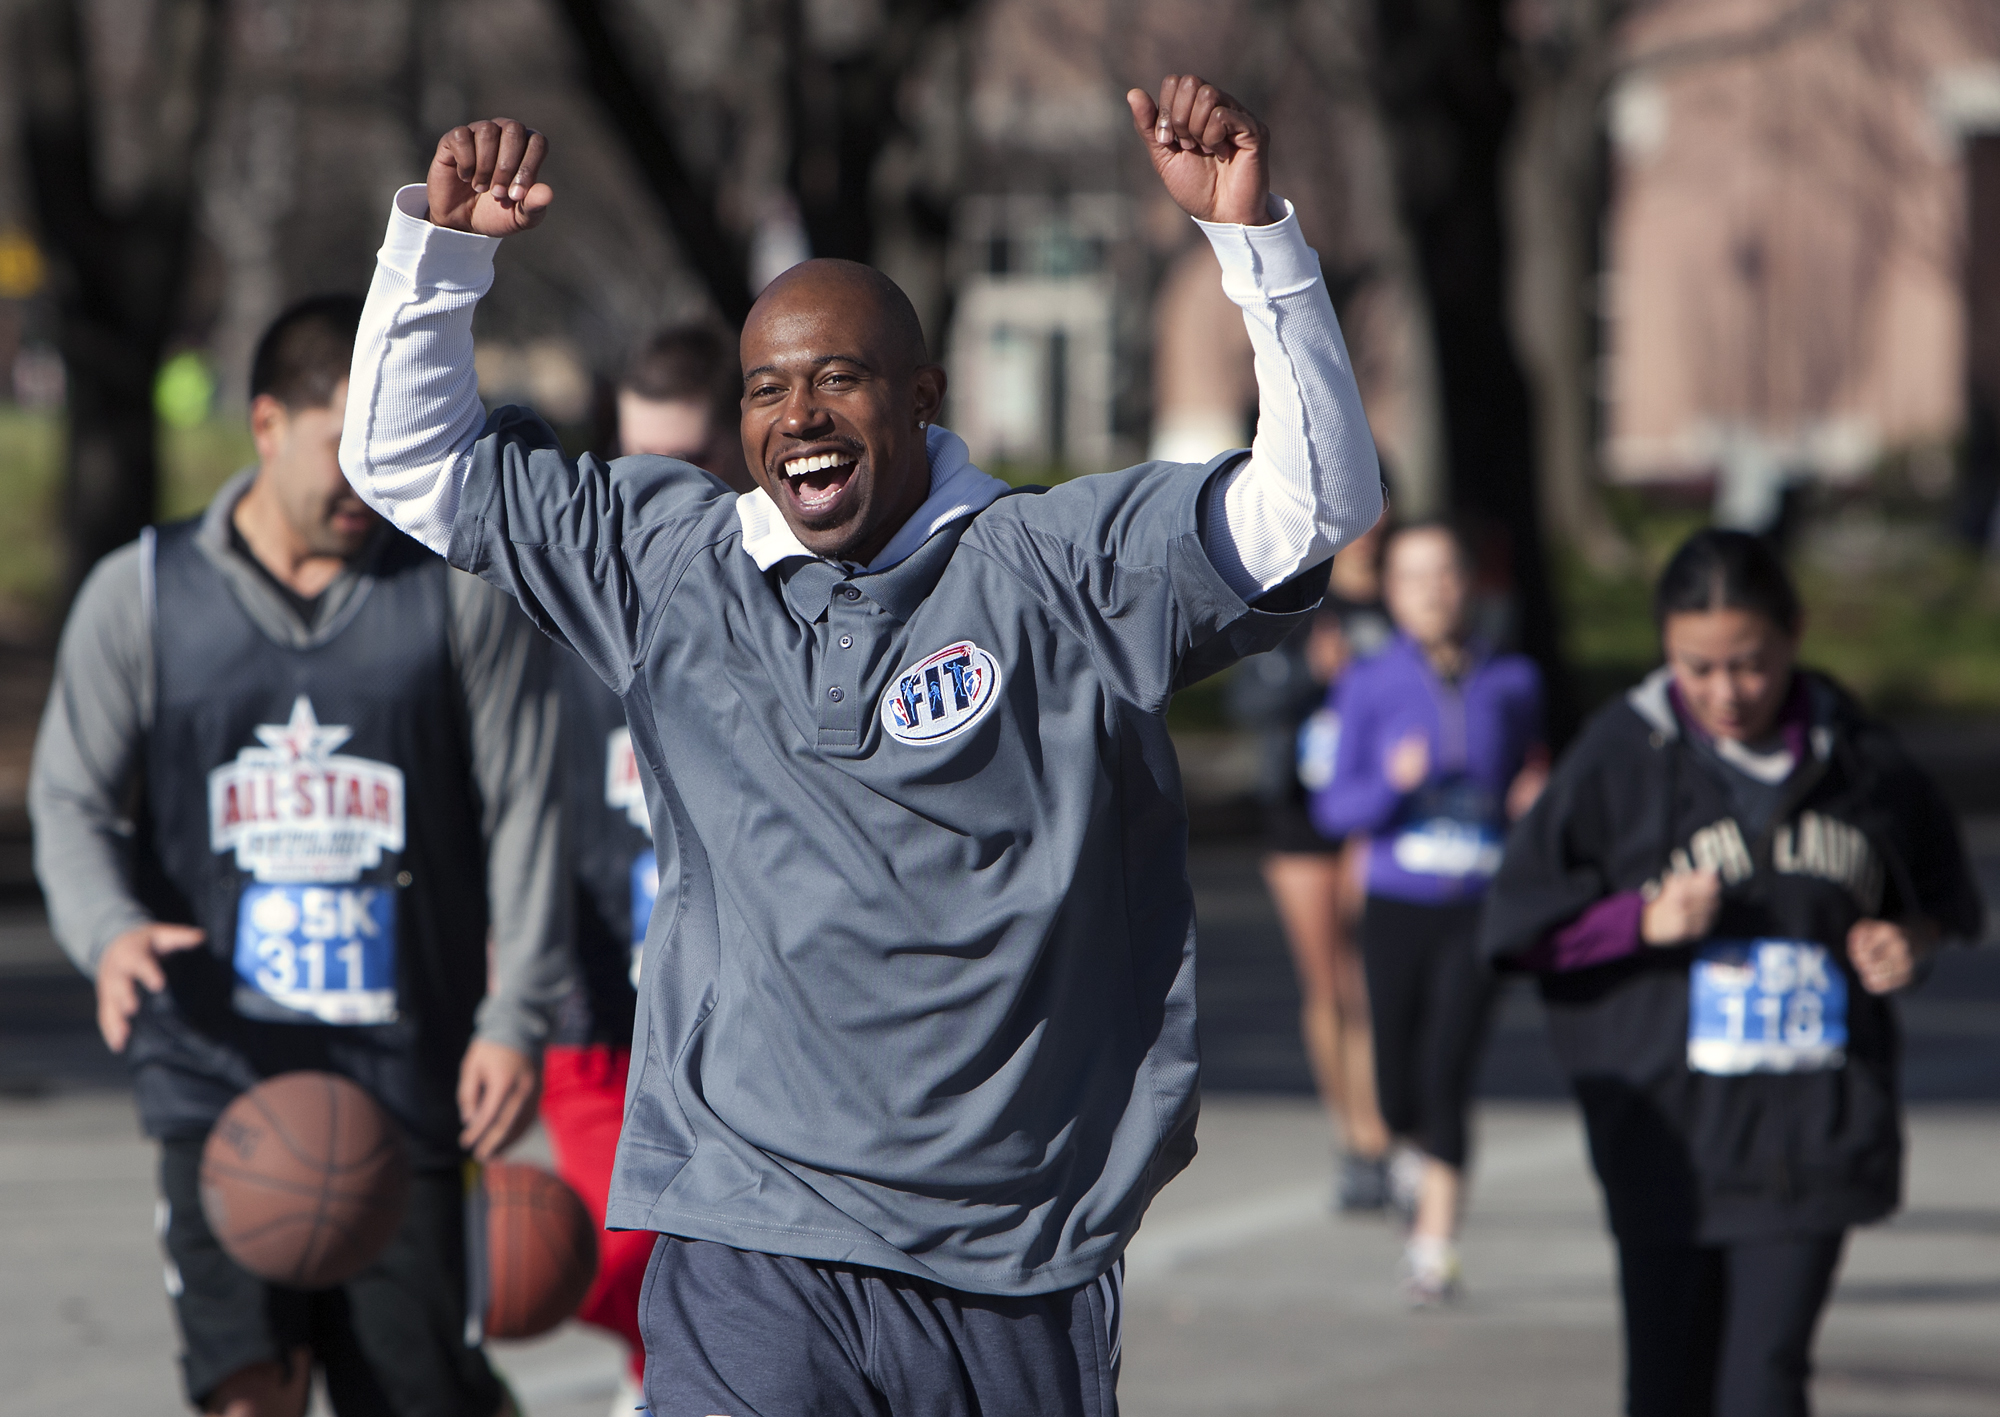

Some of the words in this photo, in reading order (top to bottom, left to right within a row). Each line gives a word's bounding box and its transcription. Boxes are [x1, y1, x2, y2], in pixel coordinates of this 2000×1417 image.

[899, 654, 971, 729] FIT
[302, 886, 381, 940] 5K
[255, 937, 365, 994] 311
[1757, 942, 1830, 995] 5K
